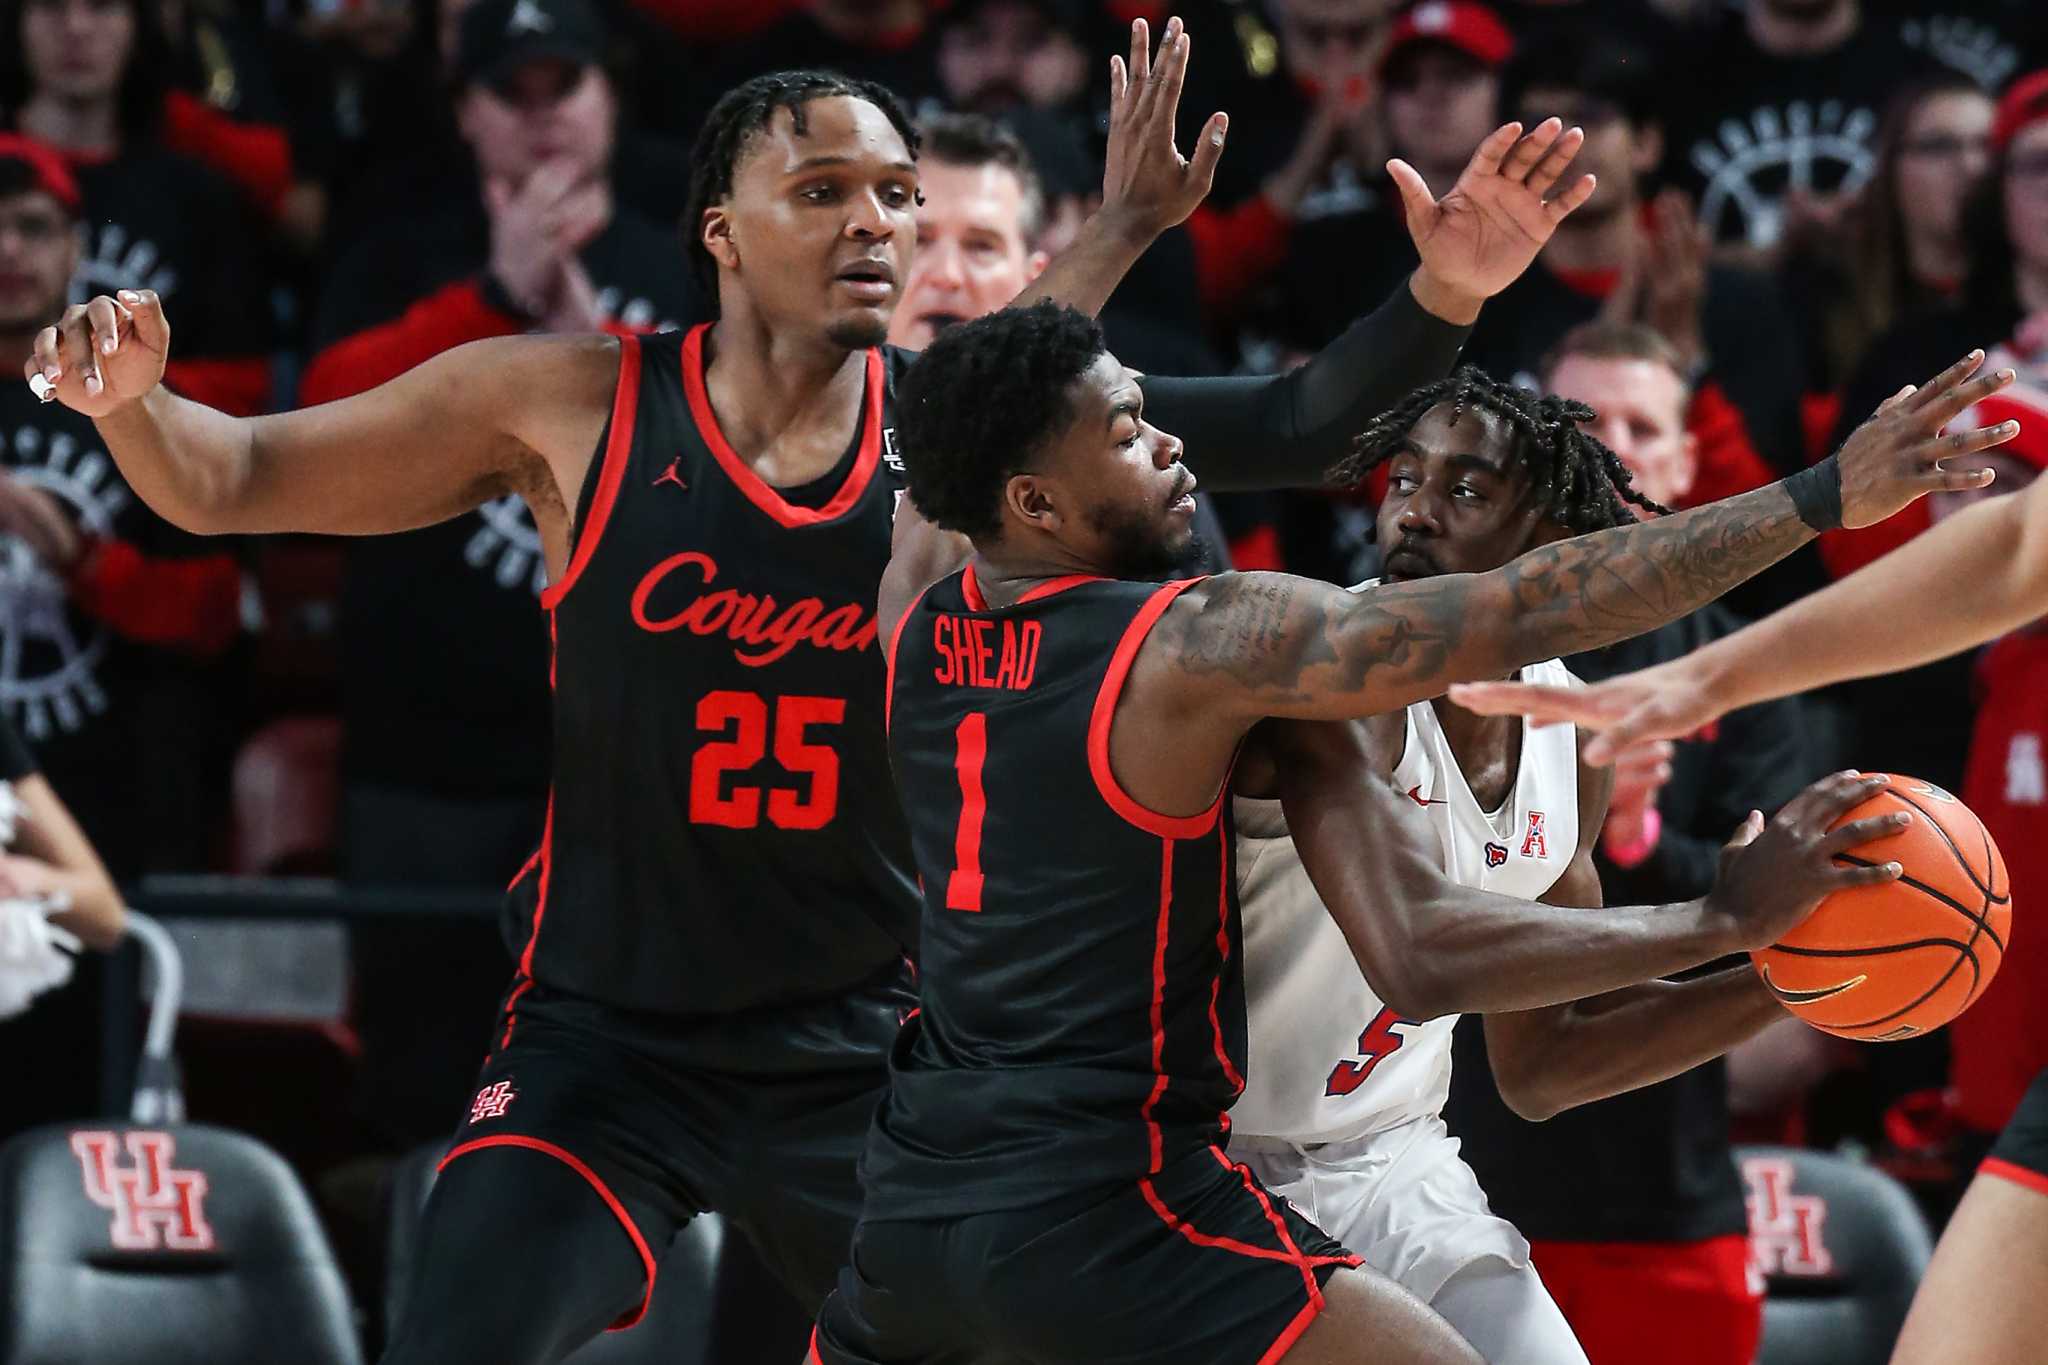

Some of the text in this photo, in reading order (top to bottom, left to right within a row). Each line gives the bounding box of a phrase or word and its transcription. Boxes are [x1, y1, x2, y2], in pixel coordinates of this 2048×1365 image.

[934, 613, 1042, 690] SHEAD
[689, 690, 845, 830] 25
[946, 712, 987, 912] 1
[1325, 1004, 1422, 1096] 5
[70, 1131, 215, 1249] UH
